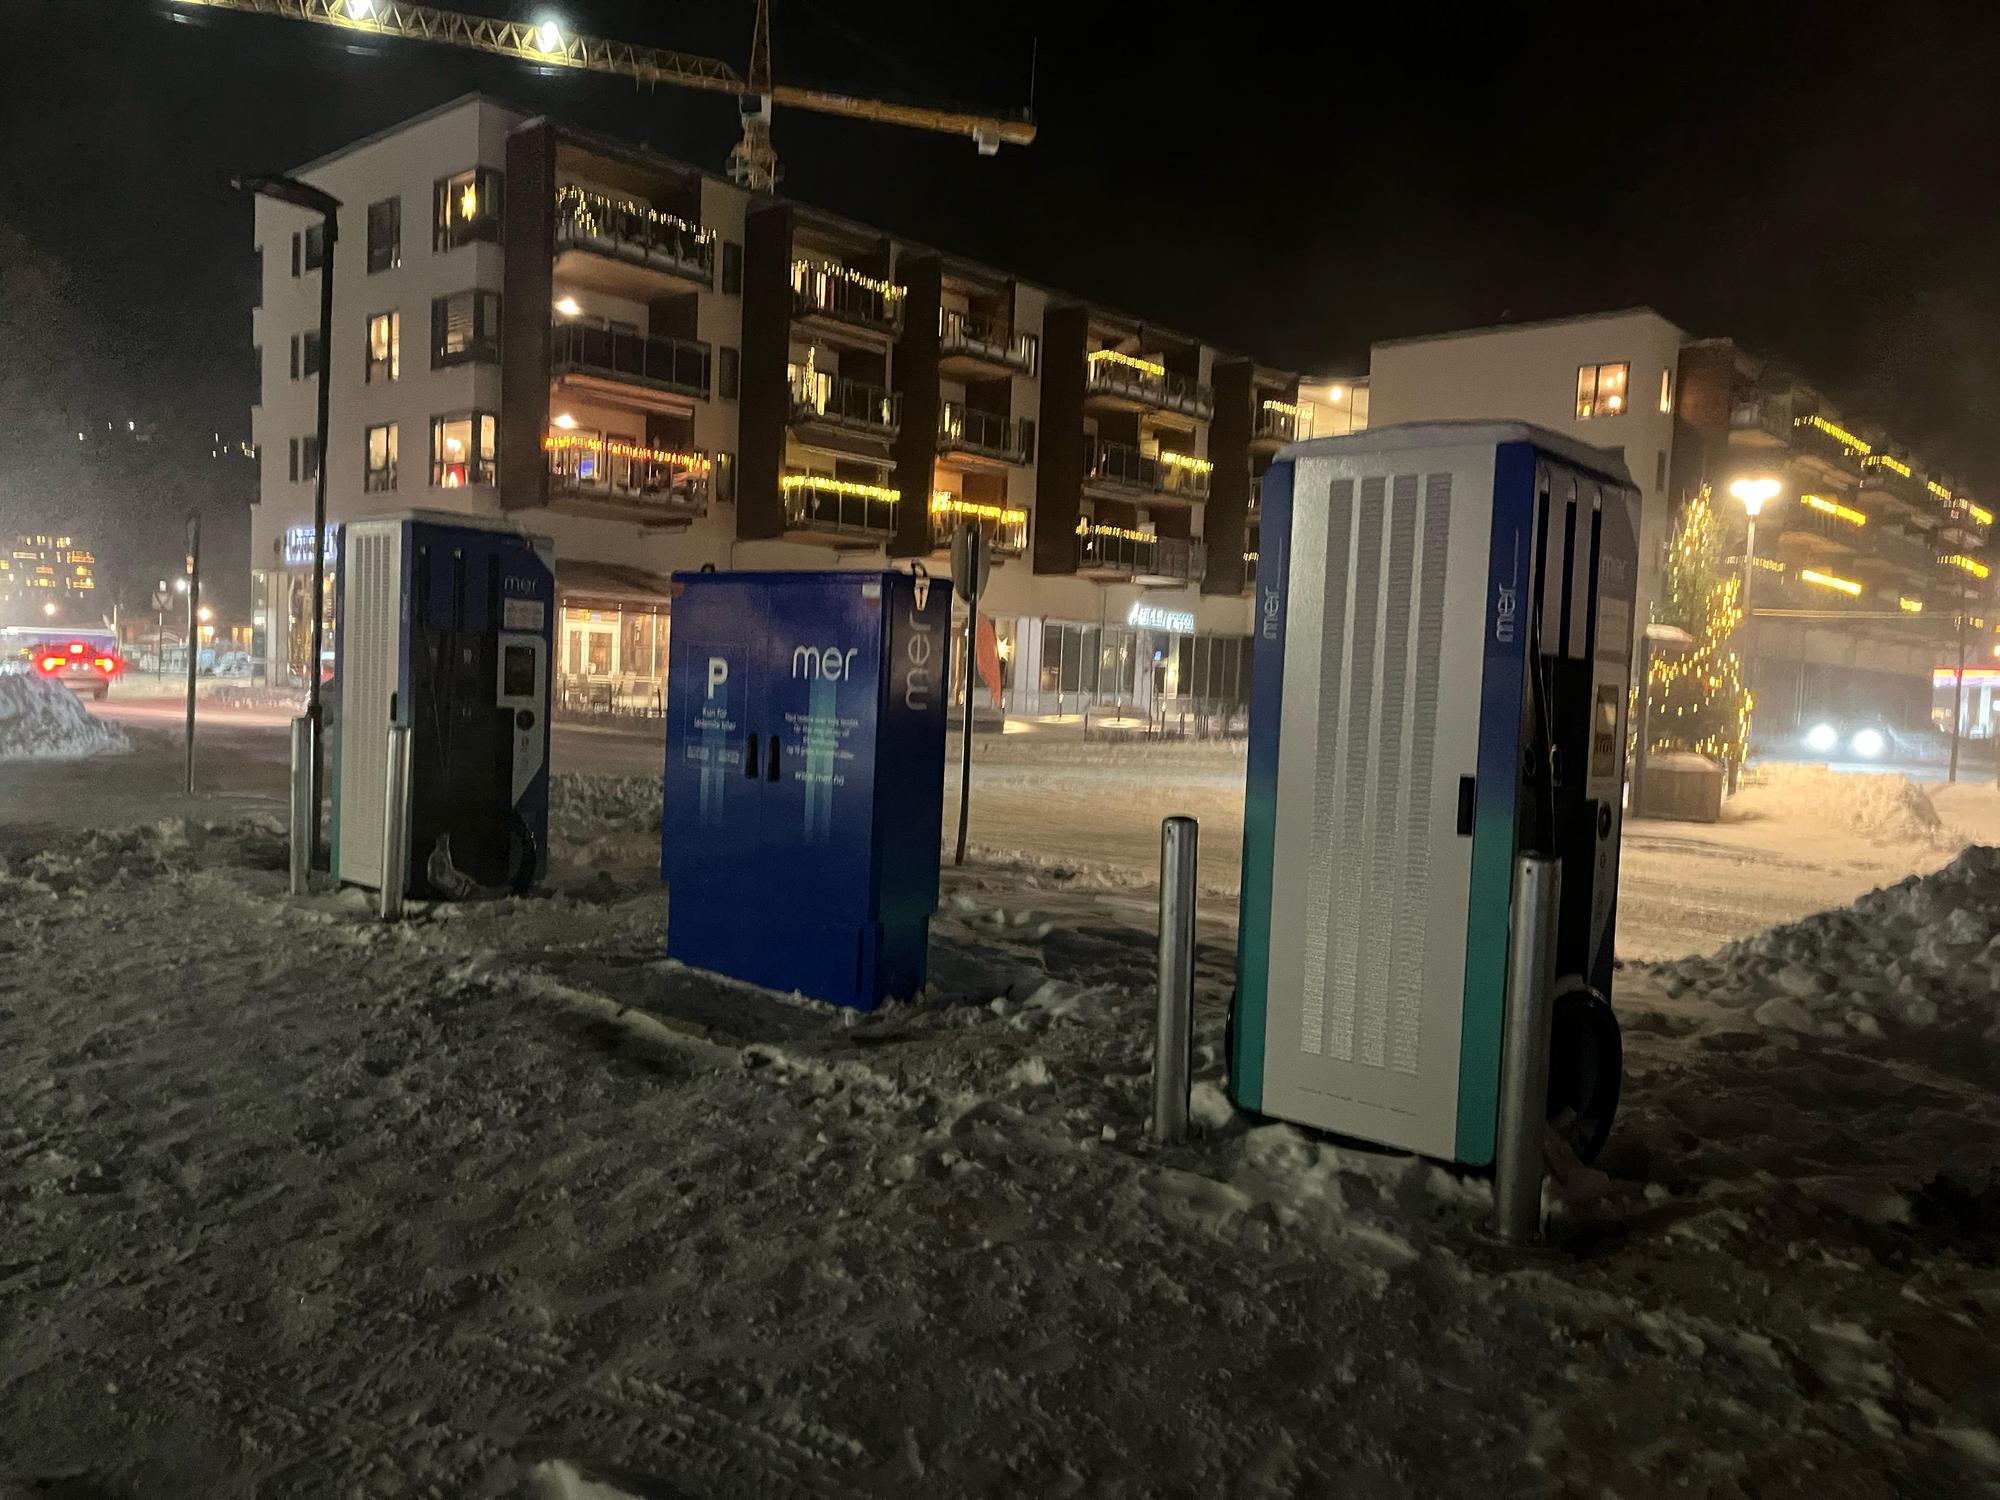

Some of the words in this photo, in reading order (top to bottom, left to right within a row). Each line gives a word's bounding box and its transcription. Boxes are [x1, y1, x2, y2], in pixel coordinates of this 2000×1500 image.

[504, 575, 540, 594] mer
[1262, 584, 1280, 640] mer
[1495, 582, 1517, 643] mer
[707, 657, 729, 700] P
[792, 645, 859, 682] mer
[905, 609, 932, 711] mer
